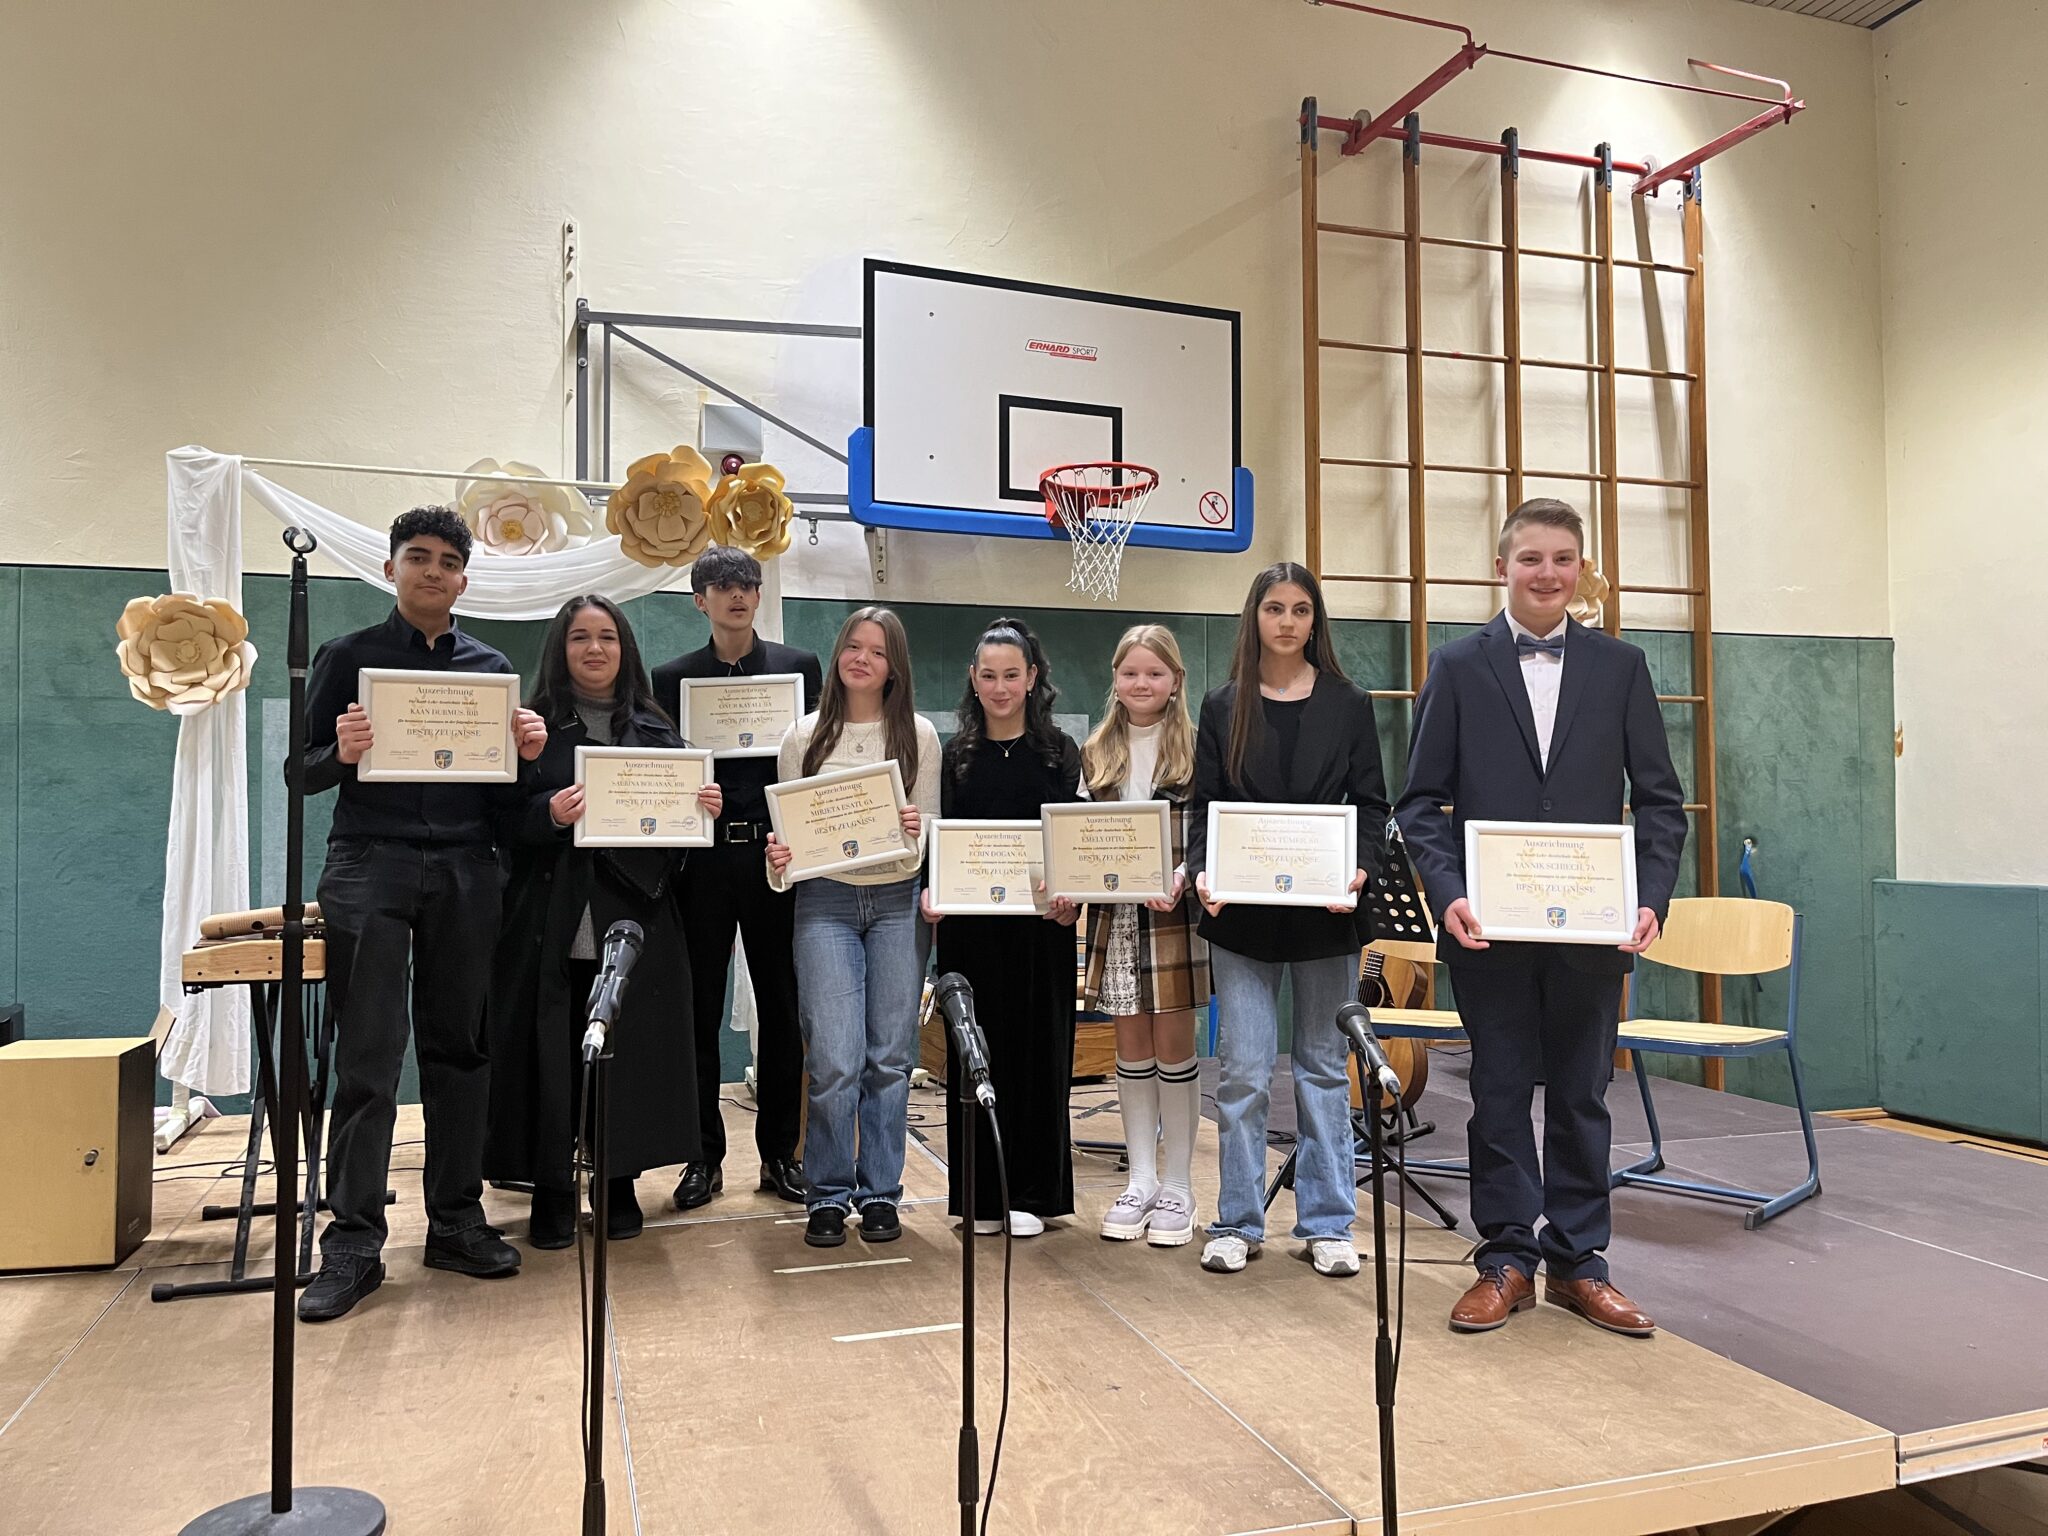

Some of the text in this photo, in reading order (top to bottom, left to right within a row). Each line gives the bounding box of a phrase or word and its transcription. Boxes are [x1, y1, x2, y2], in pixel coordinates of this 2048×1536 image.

[1029, 341, 1094, 356] ERHARD SPORT
[416, 686, 474, 696] Auszeichnung
[406, 728, 481, 737] BESTE ZEUGNISSE
[624, 761, 674, 770] Auszeichnung
[814, 782, 863, 797] Auszeichnung
[1086, 816, 1132, 824] Auszeichnung
[814, 816, 876, 835] BESTE ZEUGNISSE
[974, 832, 1022, 840] Auszeichnung
[1523, 839, 1584, 850] Auszeichnung
[1513, 862, 1544, 871] YANNIK
[1585, 864, 1596, 872] 7A
[1515, 883, 1596, 893] BESTE ZEUGNISSE
